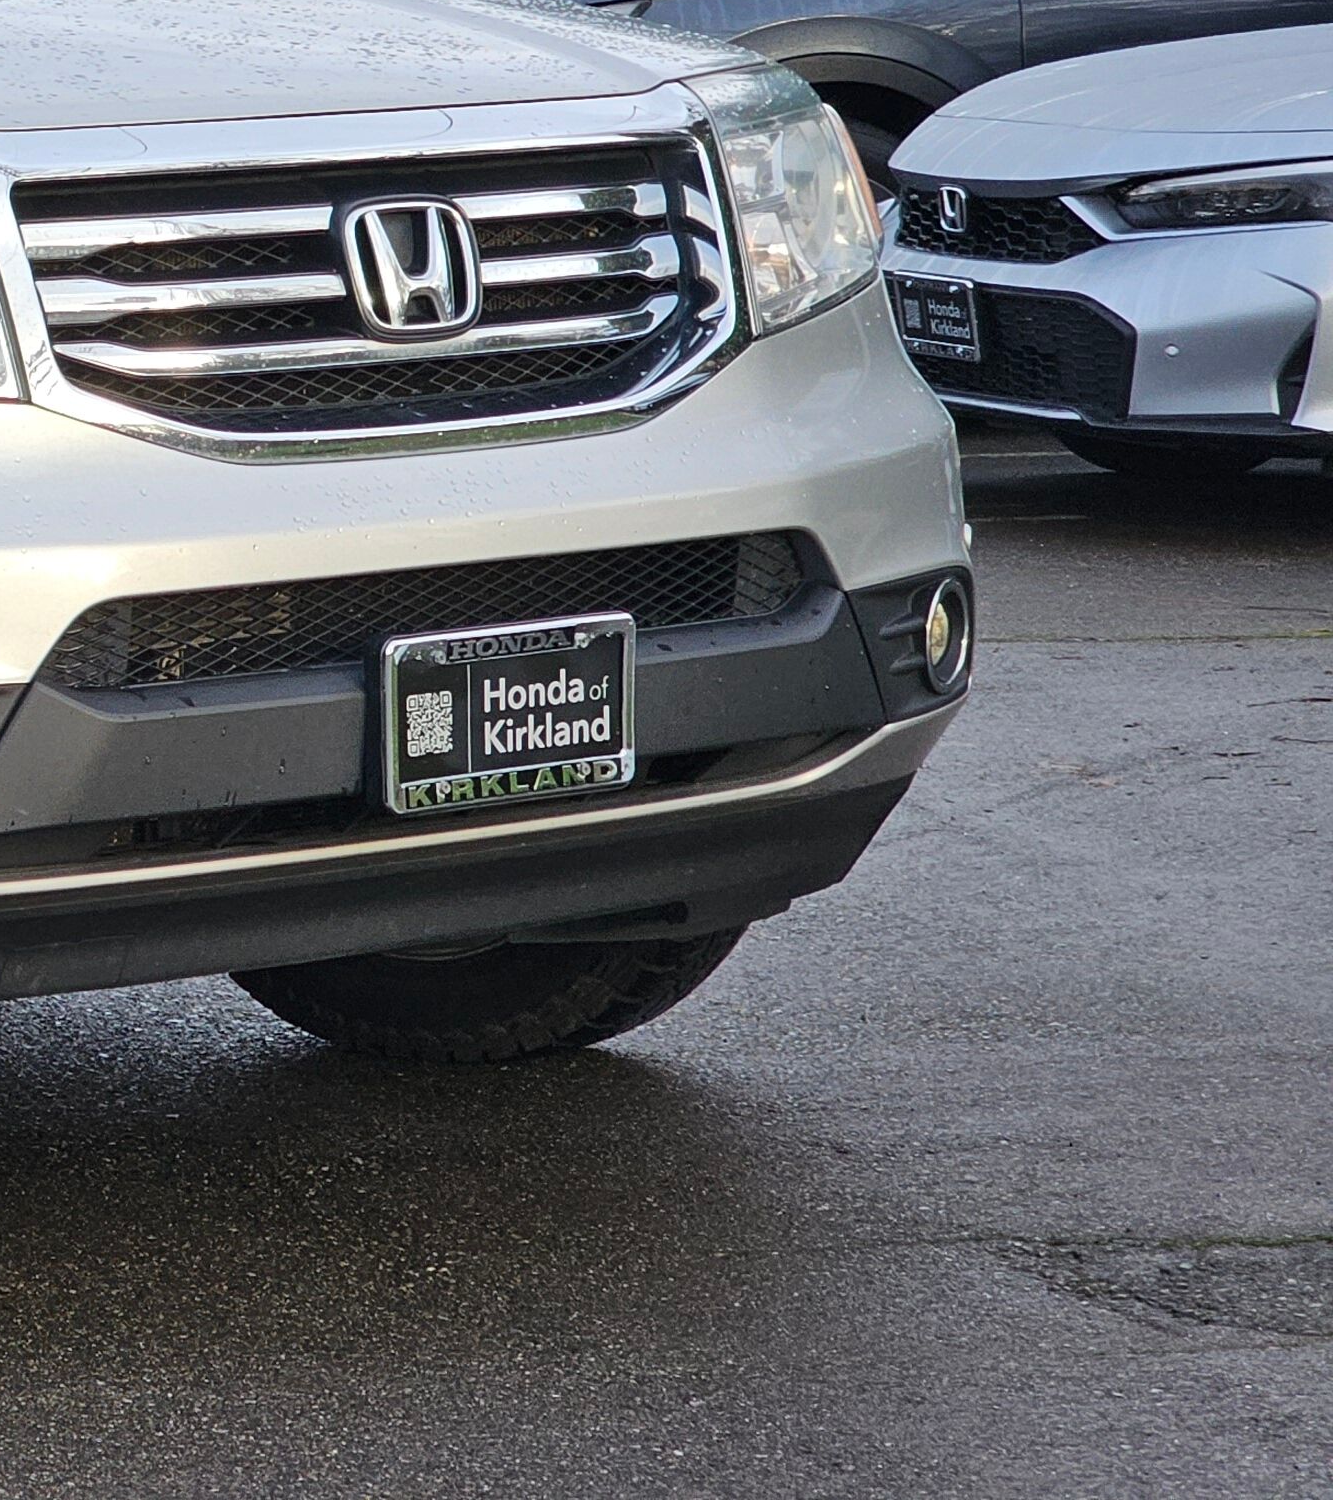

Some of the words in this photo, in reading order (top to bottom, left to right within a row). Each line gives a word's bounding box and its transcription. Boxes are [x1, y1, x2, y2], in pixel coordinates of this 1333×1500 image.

[927, 299, 961, 318] Honda
[930, 319, 971, 339] Kirkland
[449, 630, 571, 659] HONDA
[484, 668, 584, 713] Honda
[589, 675, 609, 700] of
[484, 705, 610, 755] Kirkland
[408, 760, 617, 808] KIRKLAND
